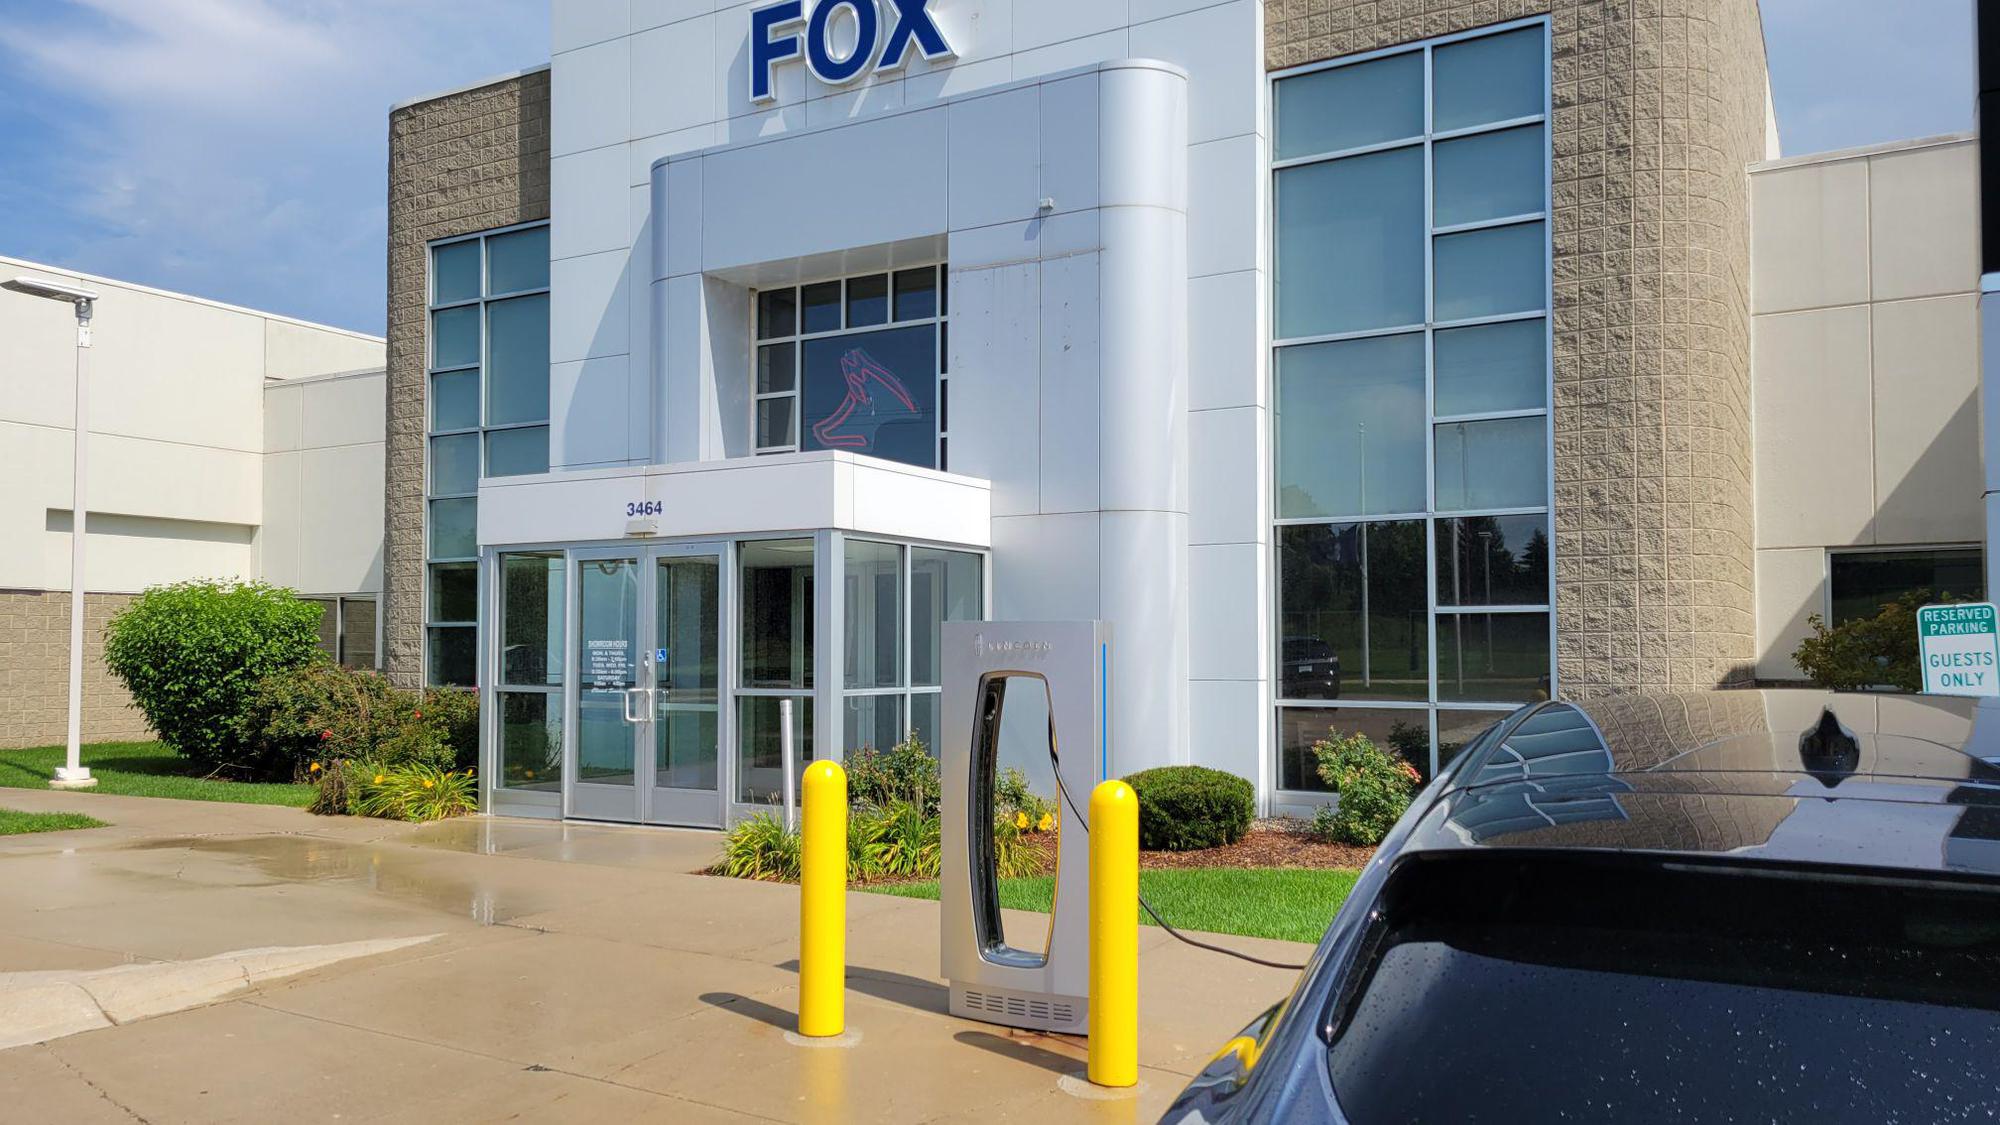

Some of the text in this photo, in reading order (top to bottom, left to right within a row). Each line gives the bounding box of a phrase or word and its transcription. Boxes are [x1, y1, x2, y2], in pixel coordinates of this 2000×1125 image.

[752, 0, 950, 100] FOX
[626, 500, 663, 517] 3464
[1923, 607, 1992, 622] RESERVED
[1930, 621, 1989, 635] PARKING
[988, 640, 1052, 650] LINCOLN
[1930, 651, 1993, 668] GUESTS
[1941, 672, 1984, 687] ONLY
